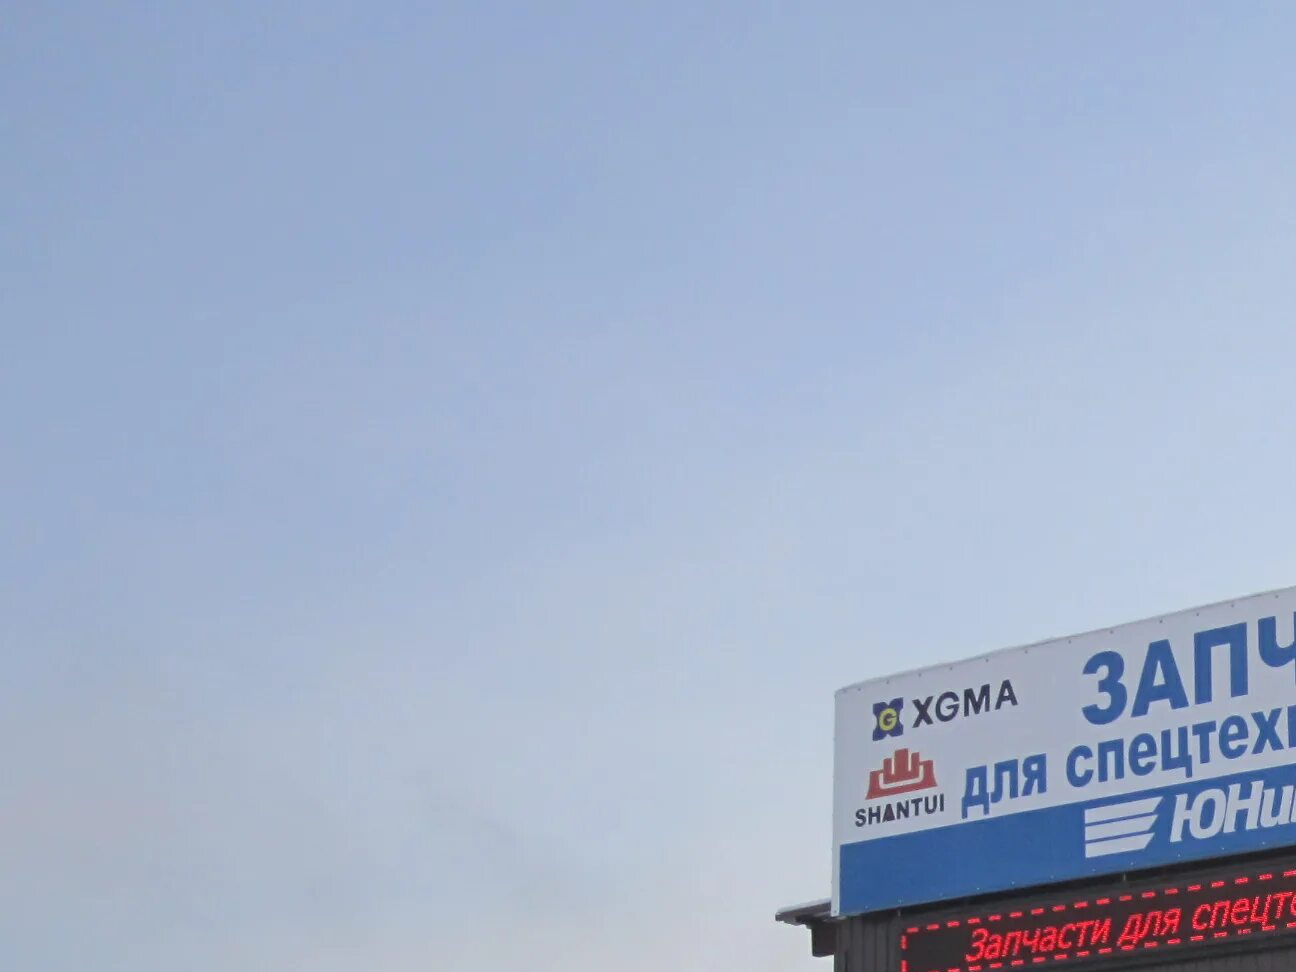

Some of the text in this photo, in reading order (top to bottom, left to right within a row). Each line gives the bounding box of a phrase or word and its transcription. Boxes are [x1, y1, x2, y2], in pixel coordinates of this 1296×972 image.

[912, 679, 1018, 728] XGMA
[855, 794, 945, 827] SHANTUI
[961, 753, 1047, 819] для
[965, 917, 1112, 963] Запчасти
[1117, 908, 1182, 948] для
